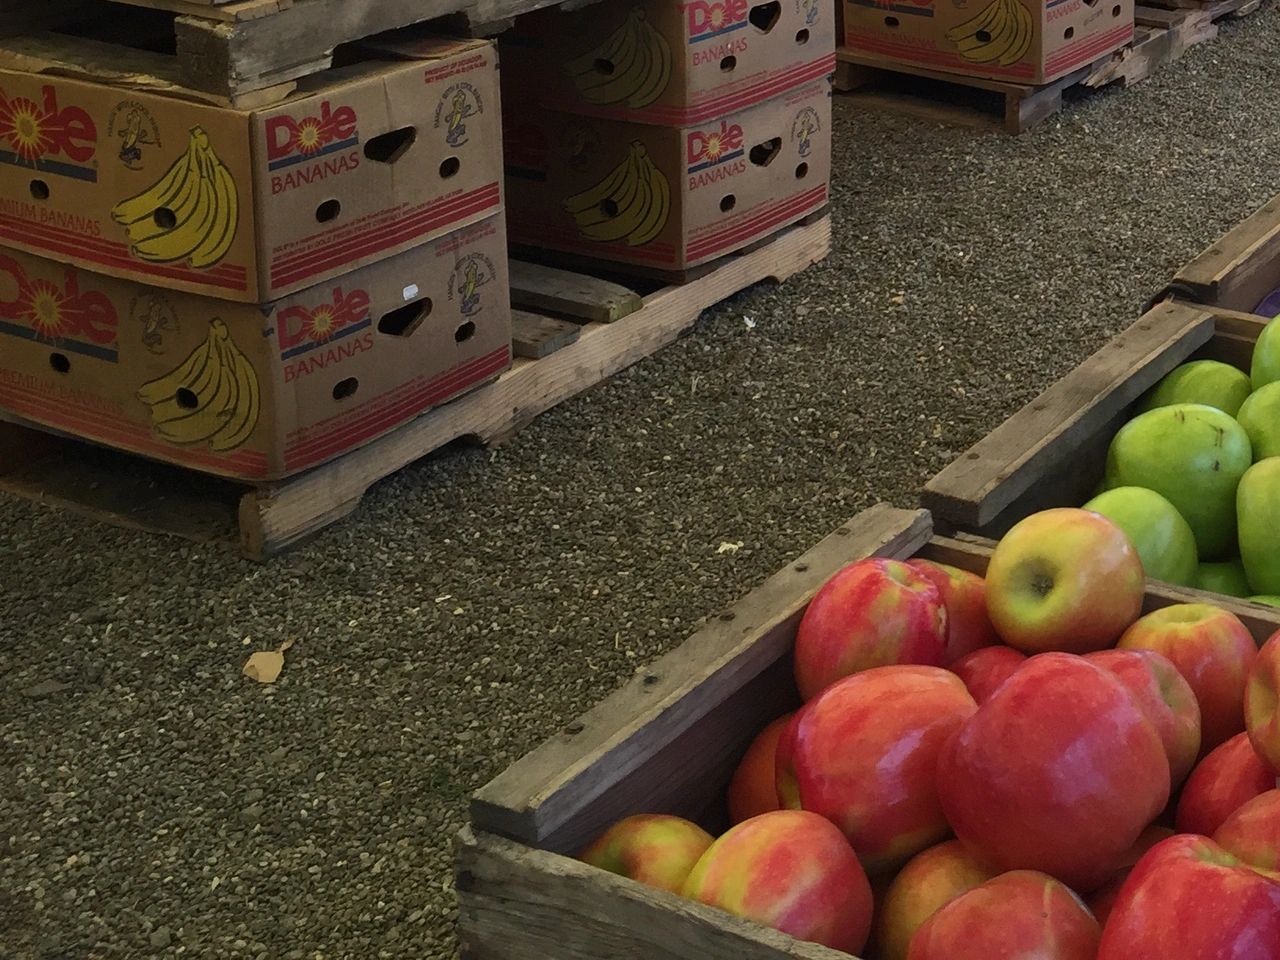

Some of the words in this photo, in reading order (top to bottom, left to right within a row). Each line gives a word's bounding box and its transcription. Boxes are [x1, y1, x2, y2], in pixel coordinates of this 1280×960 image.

[1046, 2, 1082, 23] BANANAS
[692, 37, 748, 67] BANANAS
[265, 100, 357, 161] Dole
[688, 120, 743, 165] Dole
[271, 151, 360, 195] BANANAS
[689, 159, 746, 191] BANANAS
[40, 207, 100, 236] BANANAS
[277, 286, 370, 350] Dole
[283, 332, 375, 384] BANANAS
